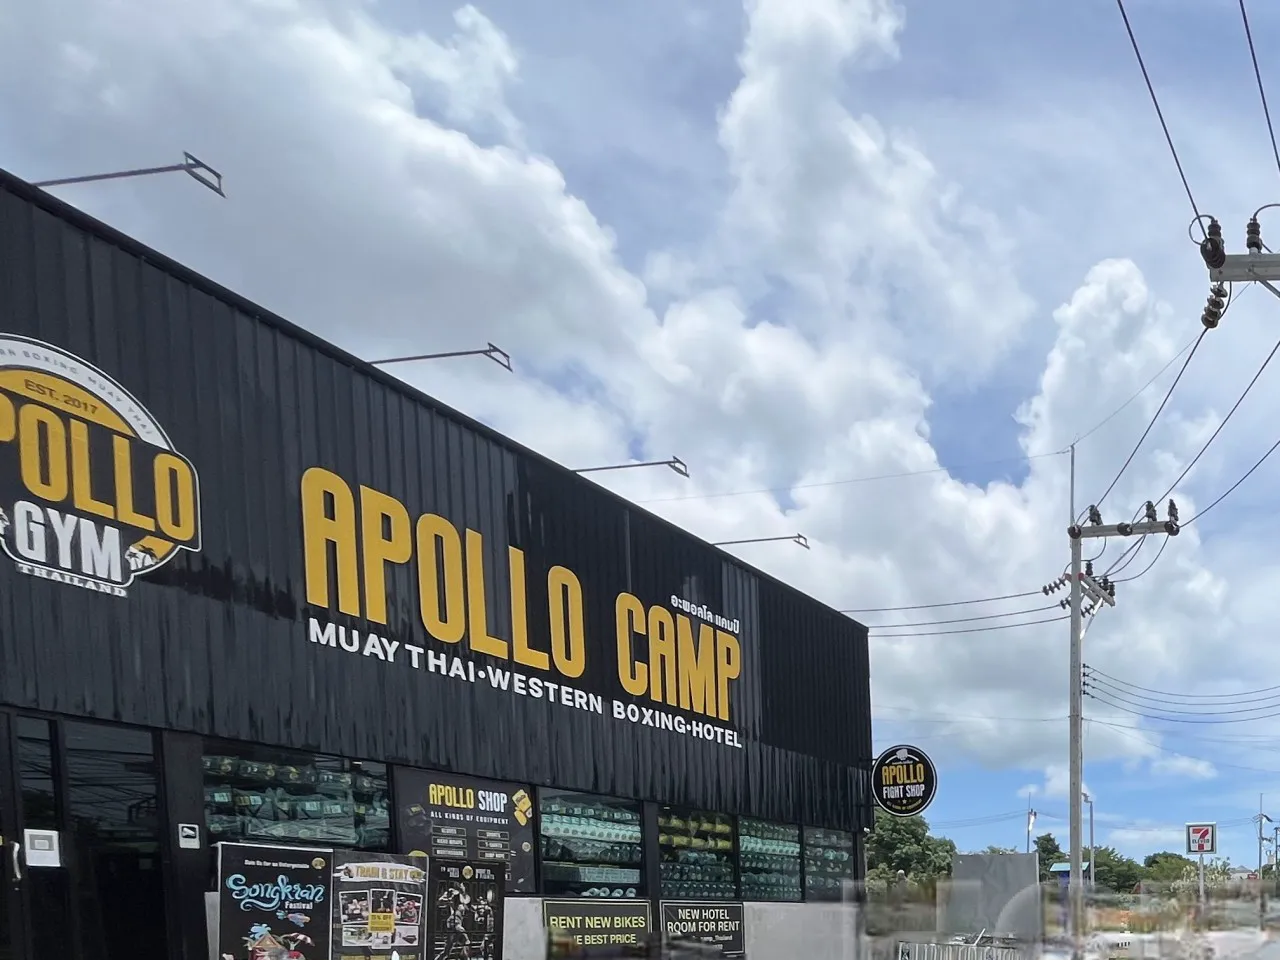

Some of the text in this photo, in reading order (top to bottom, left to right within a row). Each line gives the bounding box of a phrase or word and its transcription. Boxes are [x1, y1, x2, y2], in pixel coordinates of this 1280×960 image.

[24, 378, 100, 415] EST. 2017
[13, 500, 122, 583] GYM
[17, 563, 128, 598] THAILAND
[301, 466, 741, 722] APOLLO CAMP
[308, 617, 400, 664] MUAY
[881, 763, 925, 785] APOLLO
[428, 783, 508, 813] APOLLO SHOP
[882, 784, 925, 799] FIGHT SHOP
[430, 811, 442, 819] ALL
[444, 812, 464, 821] KINDS
[476, 815, 509, 825] EQUIPMENT
[226, 873, 326, 911] Songkran
[284, 901, 313, 910] Festival
[678, 908, 730, 920] NEW HOTEL
[550, 916, 645, 929] RENT NEW BIKES
[667, 920, 740, 933] ROOM FOR RENT
[585, 934, 608, 945] BEST
[610, 933, 637, 945] PRICE
